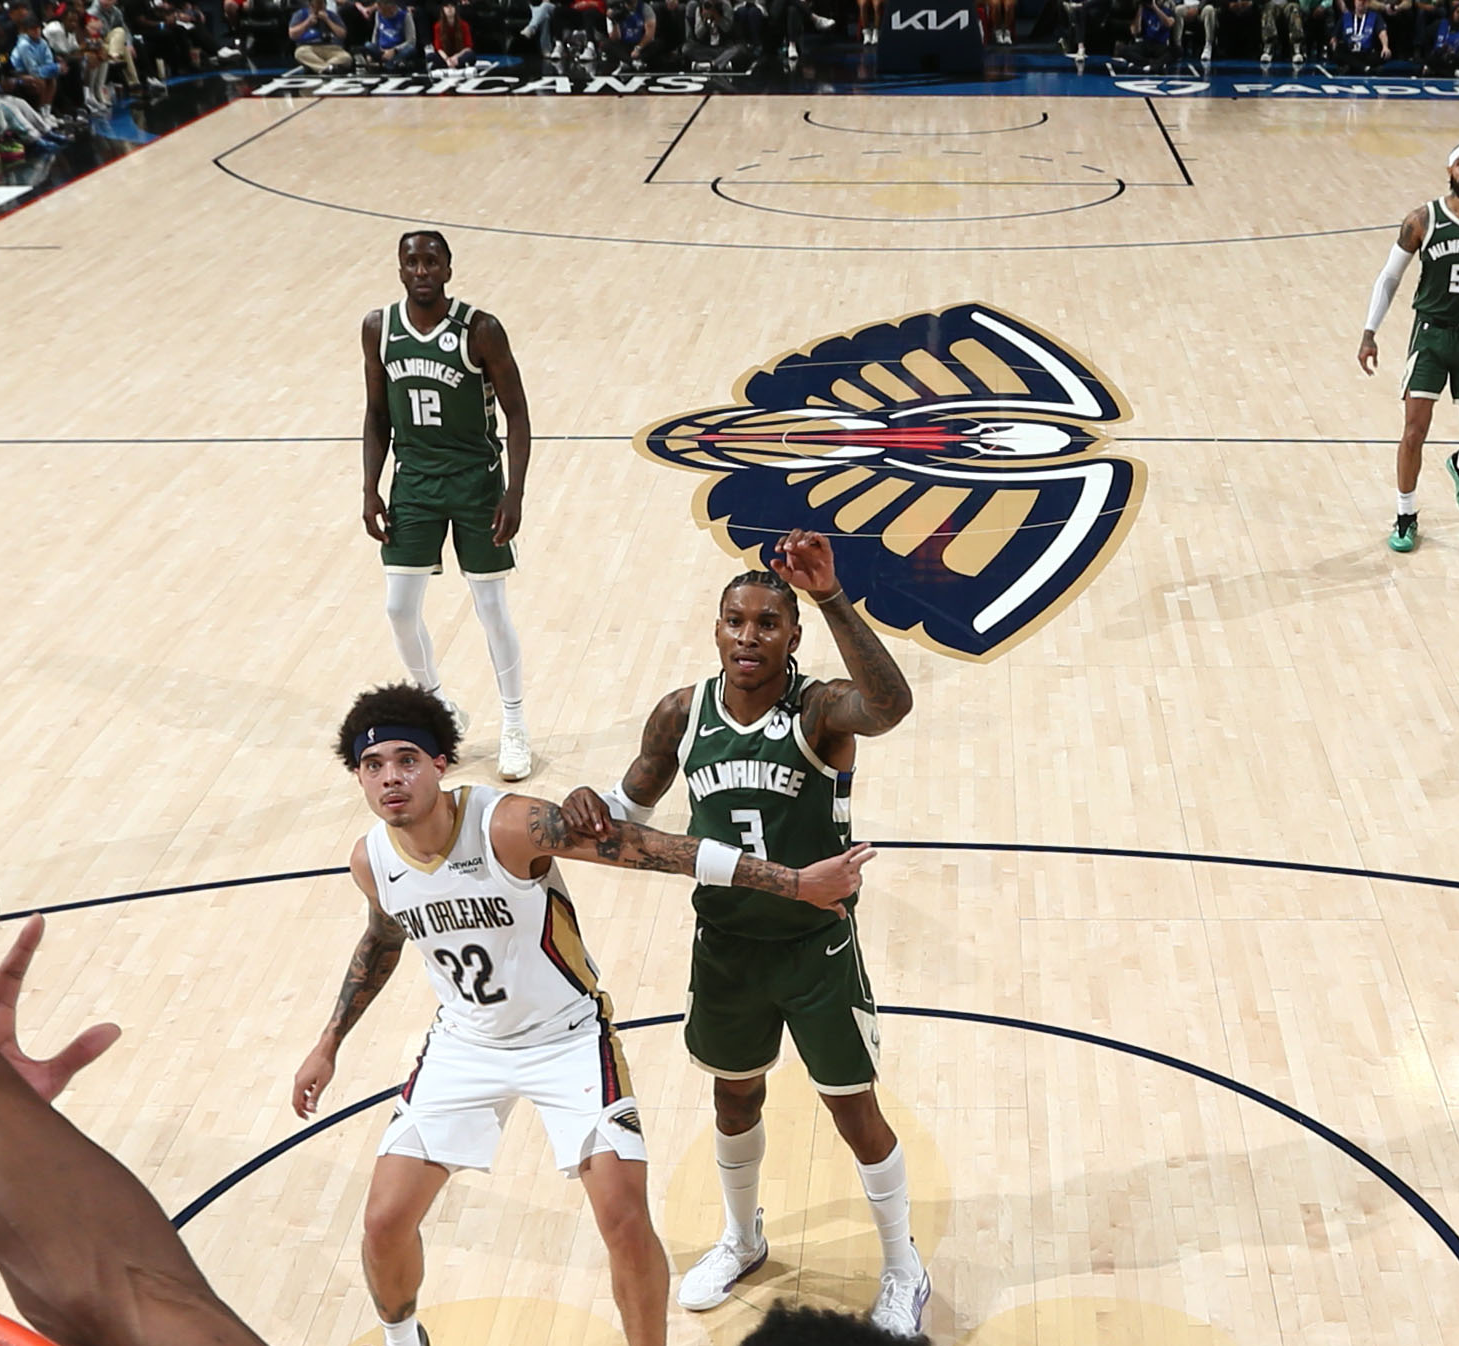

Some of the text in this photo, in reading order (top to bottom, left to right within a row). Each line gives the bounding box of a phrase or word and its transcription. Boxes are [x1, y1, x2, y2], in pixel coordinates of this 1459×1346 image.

[252, 76, 710, 95] PELICANS
[385, 358, 464, 389] MILWAUKEE
[407, 388, 442, 427] 12
[688, 760, 807, 802] MILWAUKEE
[730, 809, 769, 862] 3
[425, 896, 515, 934] ORLEANS
[433, 943, 509, 1006] 22
